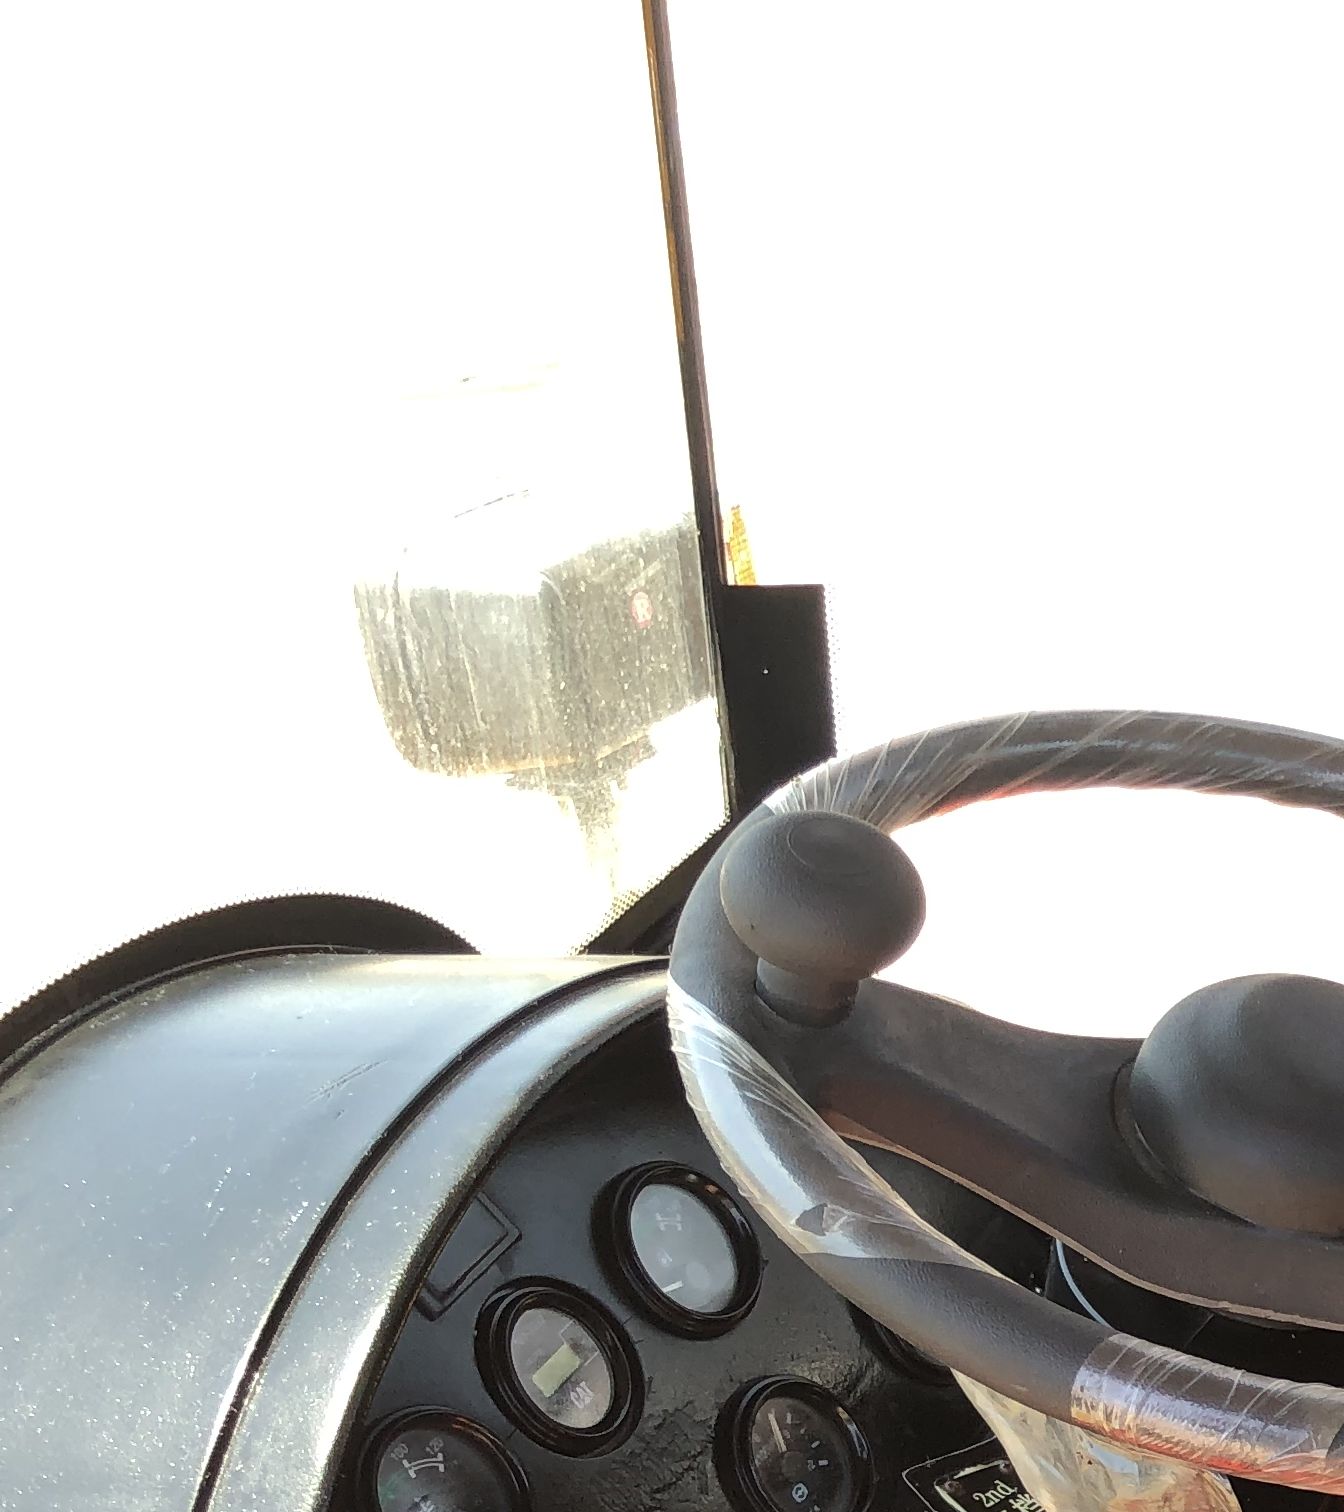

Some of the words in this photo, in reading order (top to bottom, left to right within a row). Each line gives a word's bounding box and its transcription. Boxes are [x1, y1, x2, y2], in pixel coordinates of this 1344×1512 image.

[569, 1380, 595, 1409] CAT
[390, 1443, 409, 1461] 100
[972, 1480, 1018, 1508] 2nd
